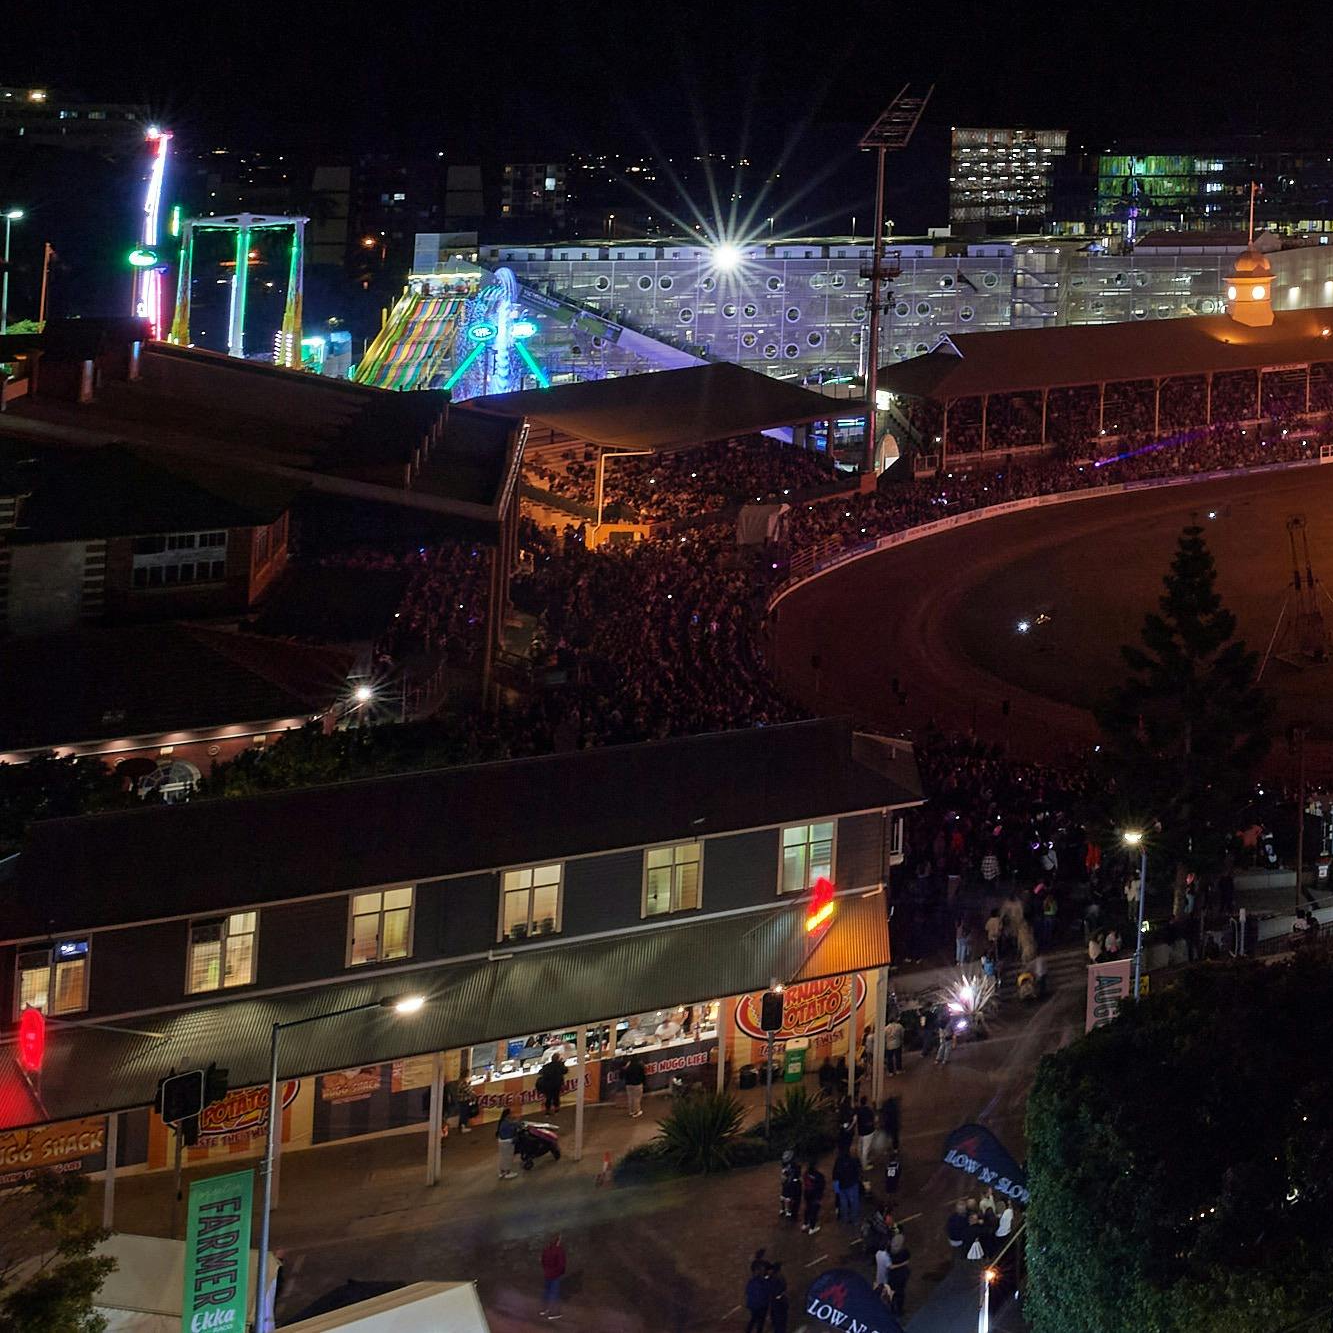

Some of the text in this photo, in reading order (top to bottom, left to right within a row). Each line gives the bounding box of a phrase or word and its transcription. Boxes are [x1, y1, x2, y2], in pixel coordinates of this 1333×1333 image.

[782, 990, 843, 1030] OTATO
[658, 1056, 685, 1073] NUGG
[685, 1051, 708, 1067] LIFE
[477, 1093, 513, 1108] TASTE
[42, 1129, 105, 1159] SHACK
[943, 1149, 981, 1174] LOW
[193, 1195, 242, 1311] FARMER
[190, 1308, 236, 1333] Ekka
[806, 1298, 849, 1328] LOW
